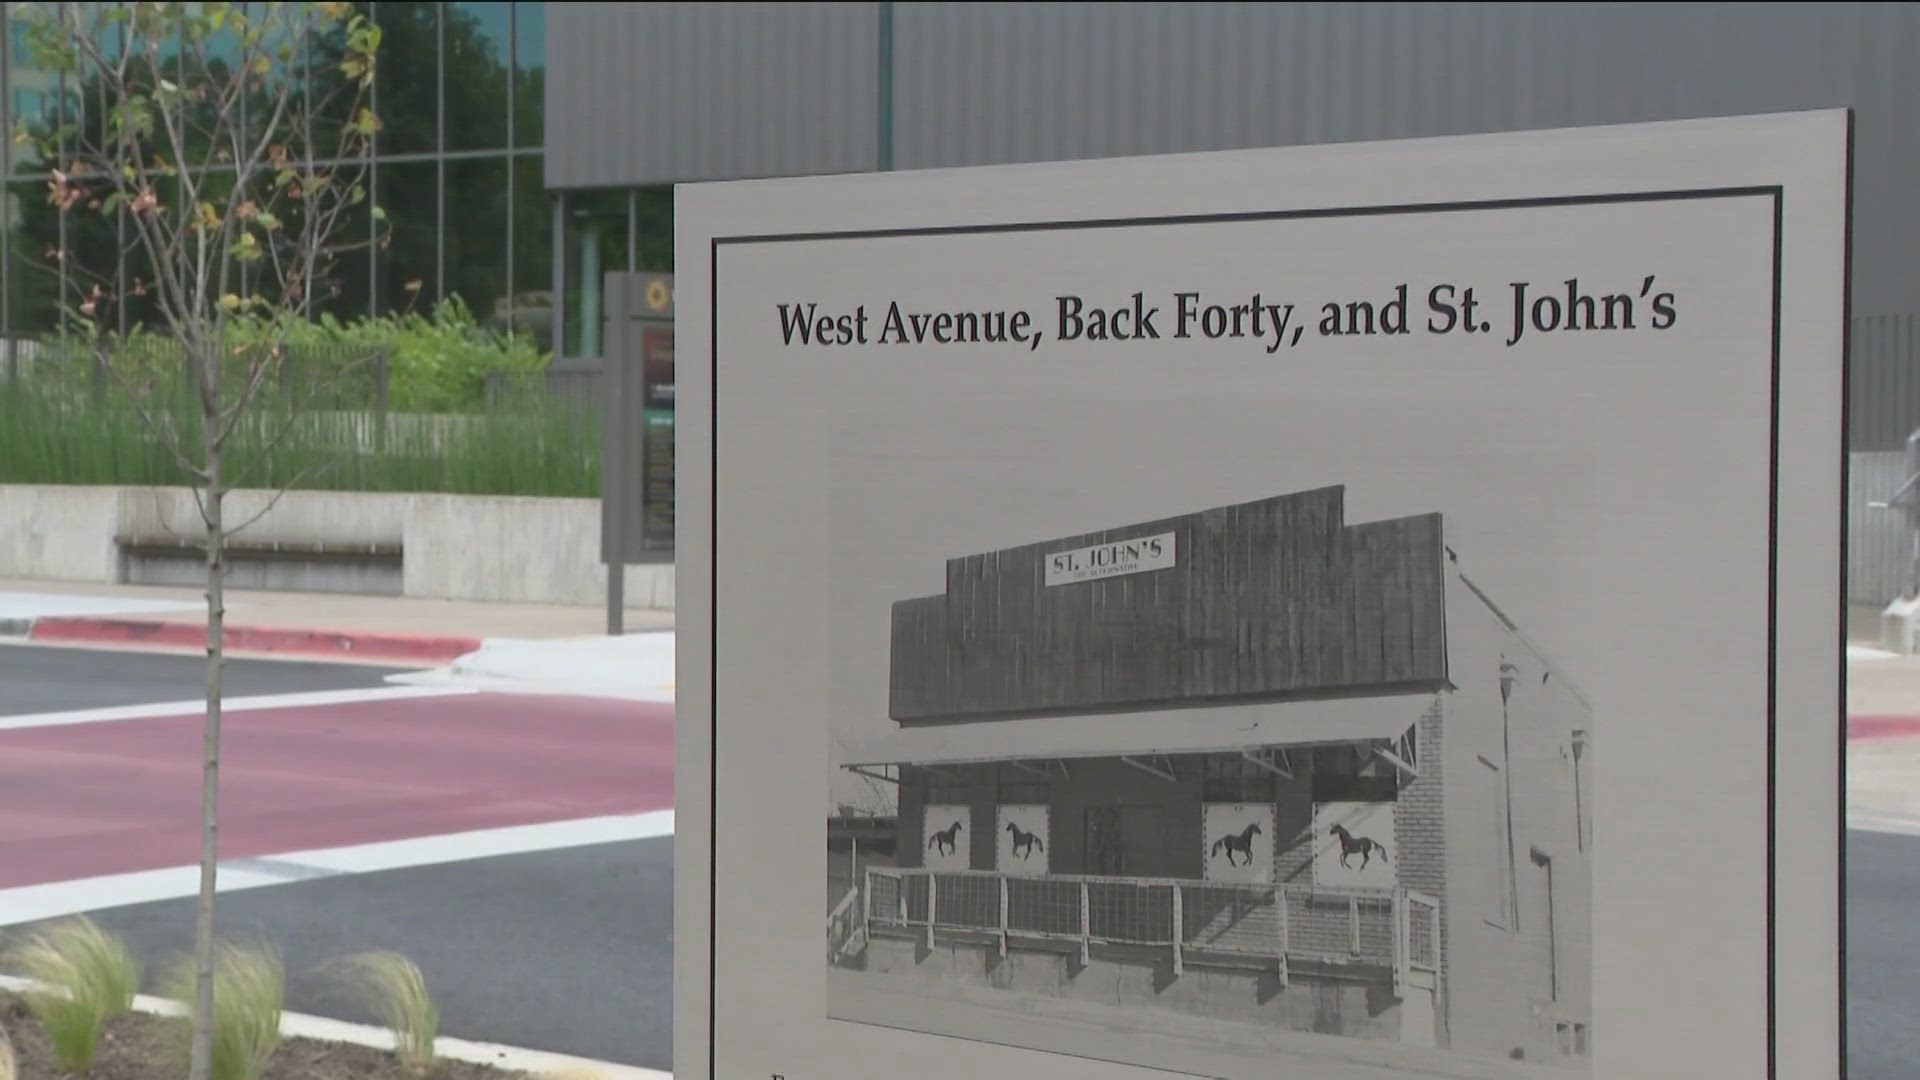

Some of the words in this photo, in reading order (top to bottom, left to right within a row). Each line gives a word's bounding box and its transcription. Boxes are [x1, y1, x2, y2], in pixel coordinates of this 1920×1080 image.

[776, 302, 869, 346] West
[877, 300, 1043, 352] Avenue,
[1055, 291, 1161, 341] Back
[1173, 291, 1304, 354] Forty,
[1318, 283, 1411, 337] and
[1427, 283, 1491, 335] St.
[1506, 274, 1677, 347] John's
[1053, 553, 1080, 574] ST.
[1085, 538, 1162, 569] JOHN'S
